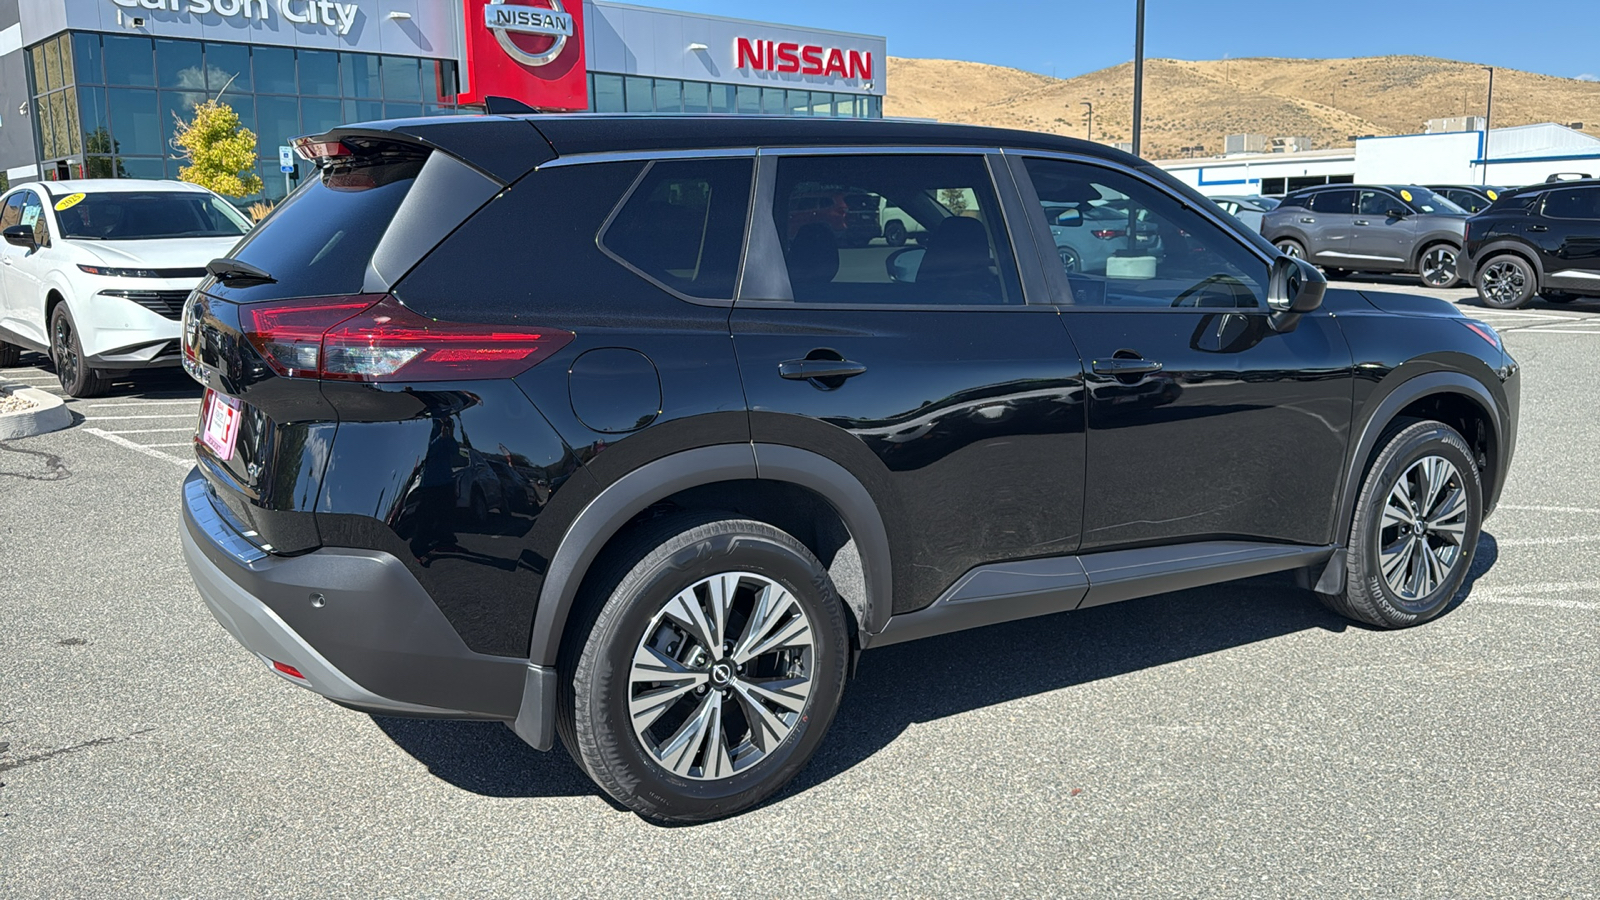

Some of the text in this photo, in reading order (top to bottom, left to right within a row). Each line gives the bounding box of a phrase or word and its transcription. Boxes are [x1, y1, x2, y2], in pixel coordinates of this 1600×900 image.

[111, 0, 359, 35] son City
[496, 9, 567, 31] NISSAN
[735, 37, 872, 80] NISSAN
[1369, 575, 1418, 622] BRIDGESTONE
